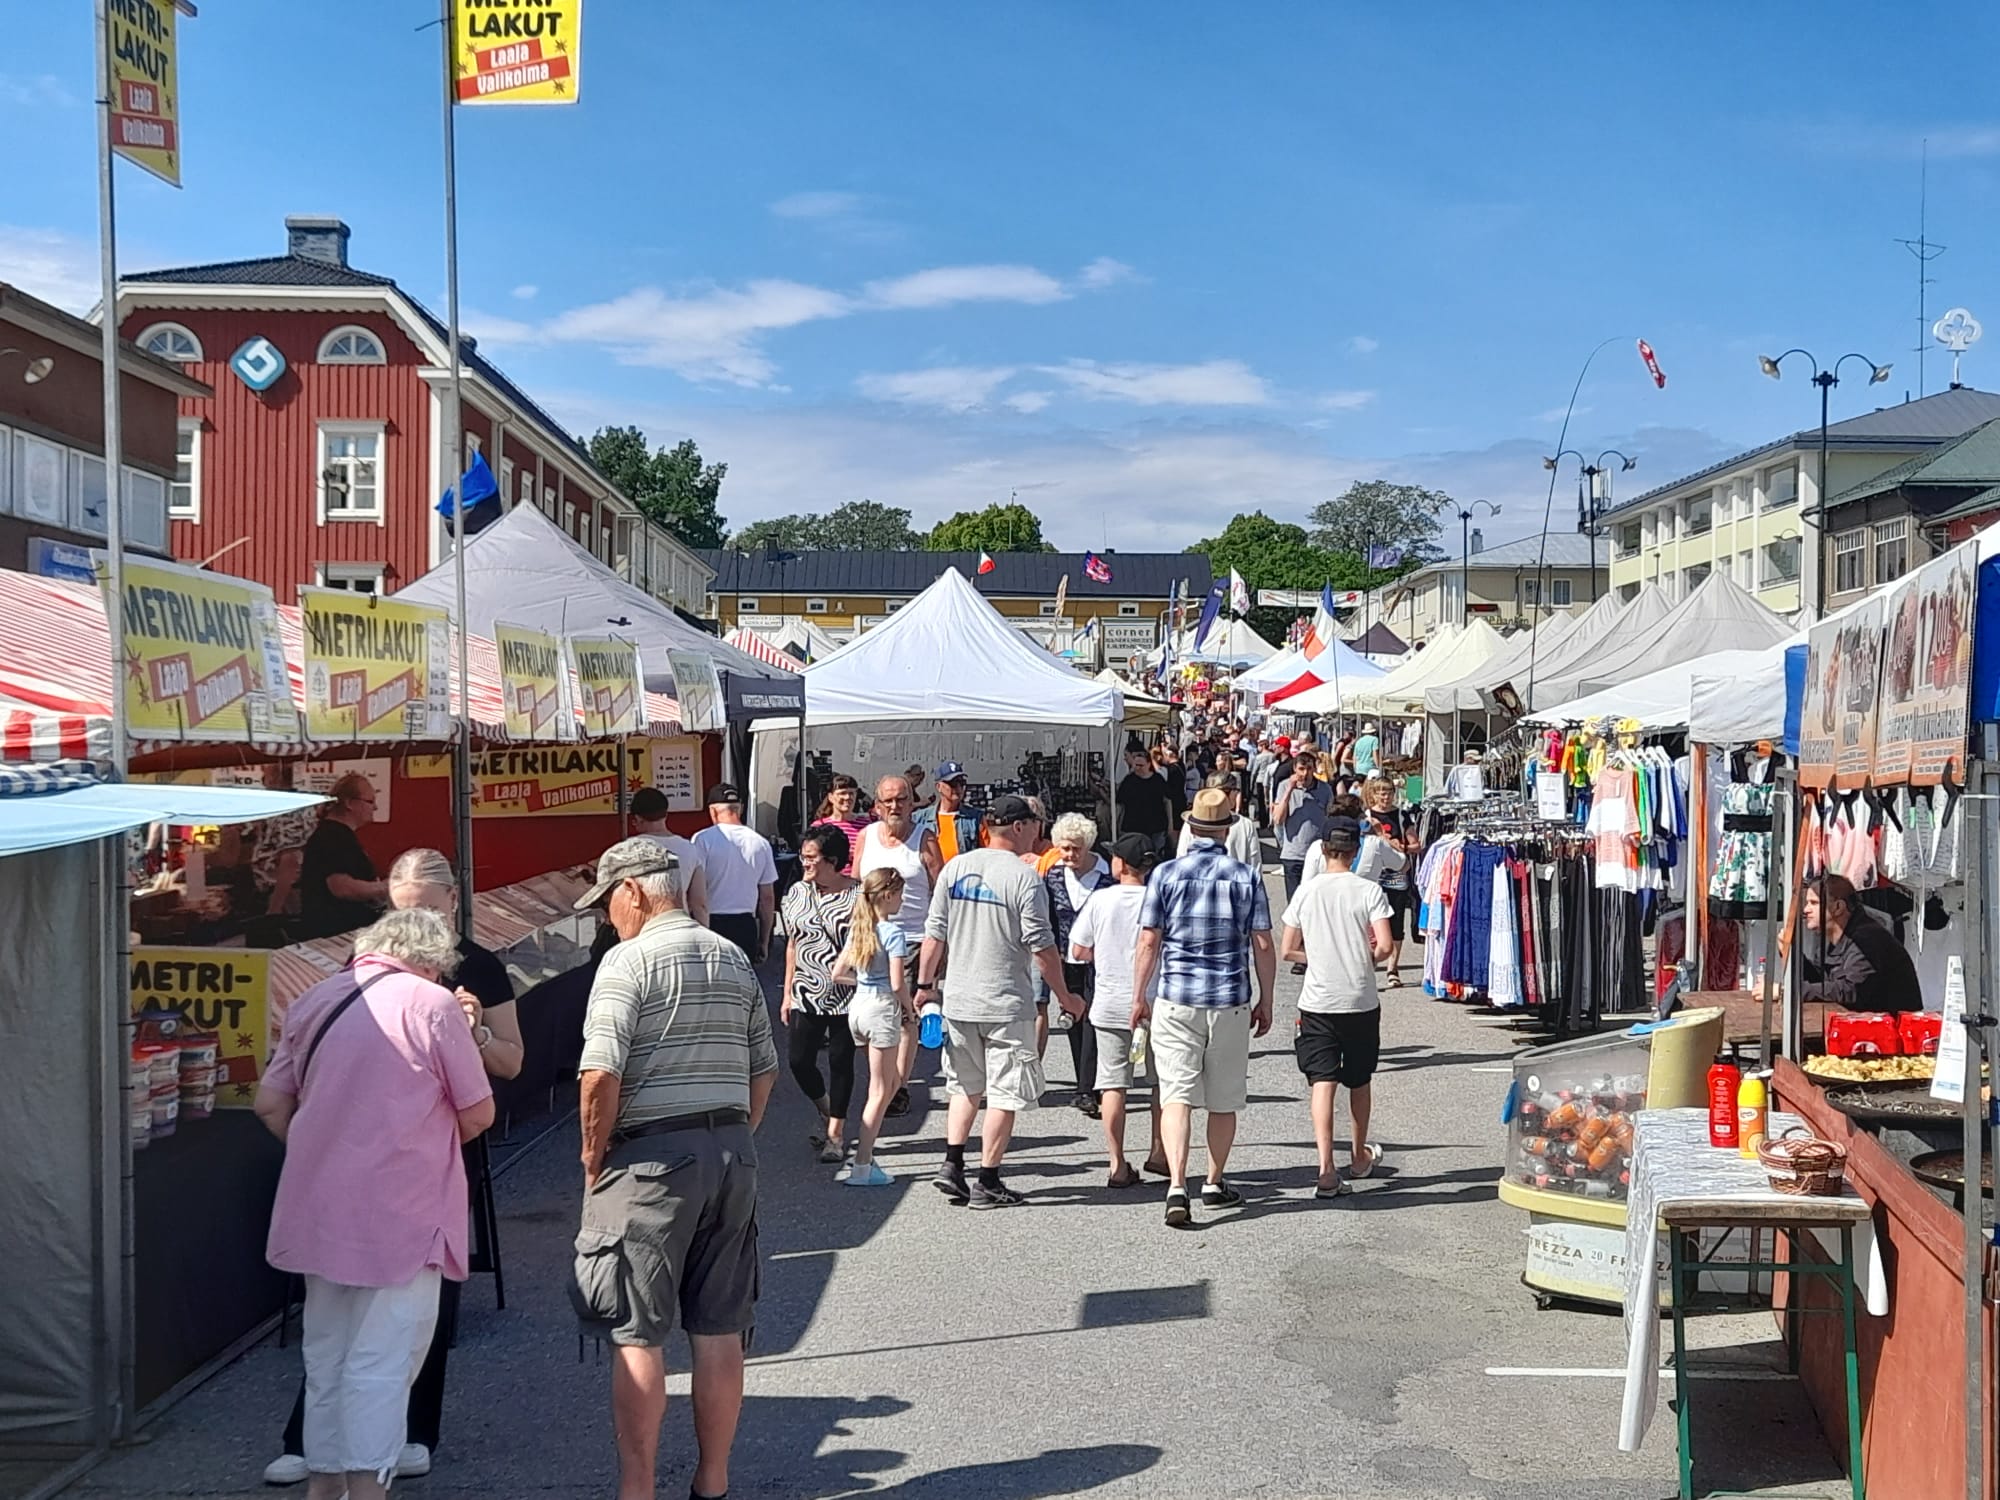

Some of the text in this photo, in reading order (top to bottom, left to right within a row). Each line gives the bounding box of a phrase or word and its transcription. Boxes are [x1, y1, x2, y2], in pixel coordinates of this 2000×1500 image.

[469, 12, 562, 38] LAKUT
[114, 20, 168, 87] LAKUT
[490, 44, 530, 69] Laaja
[476, 62, 550, 94] Valikoima
[124, 583, 255, 651] METRILAKUT
[312, 609, 425, 664] METRILAKUT
[1108, 629, 1151, 637] corner
[470, 748, 645, 776] METRILAKUT
[493, 782, 532, 800] Laaja
[542, 777, 612, 808] Valikoima
[131, 960, 253, 994] METRI-
[141, 996, 247, 1030] AKUT
[1590, 1250, 1604, 1261] 20
